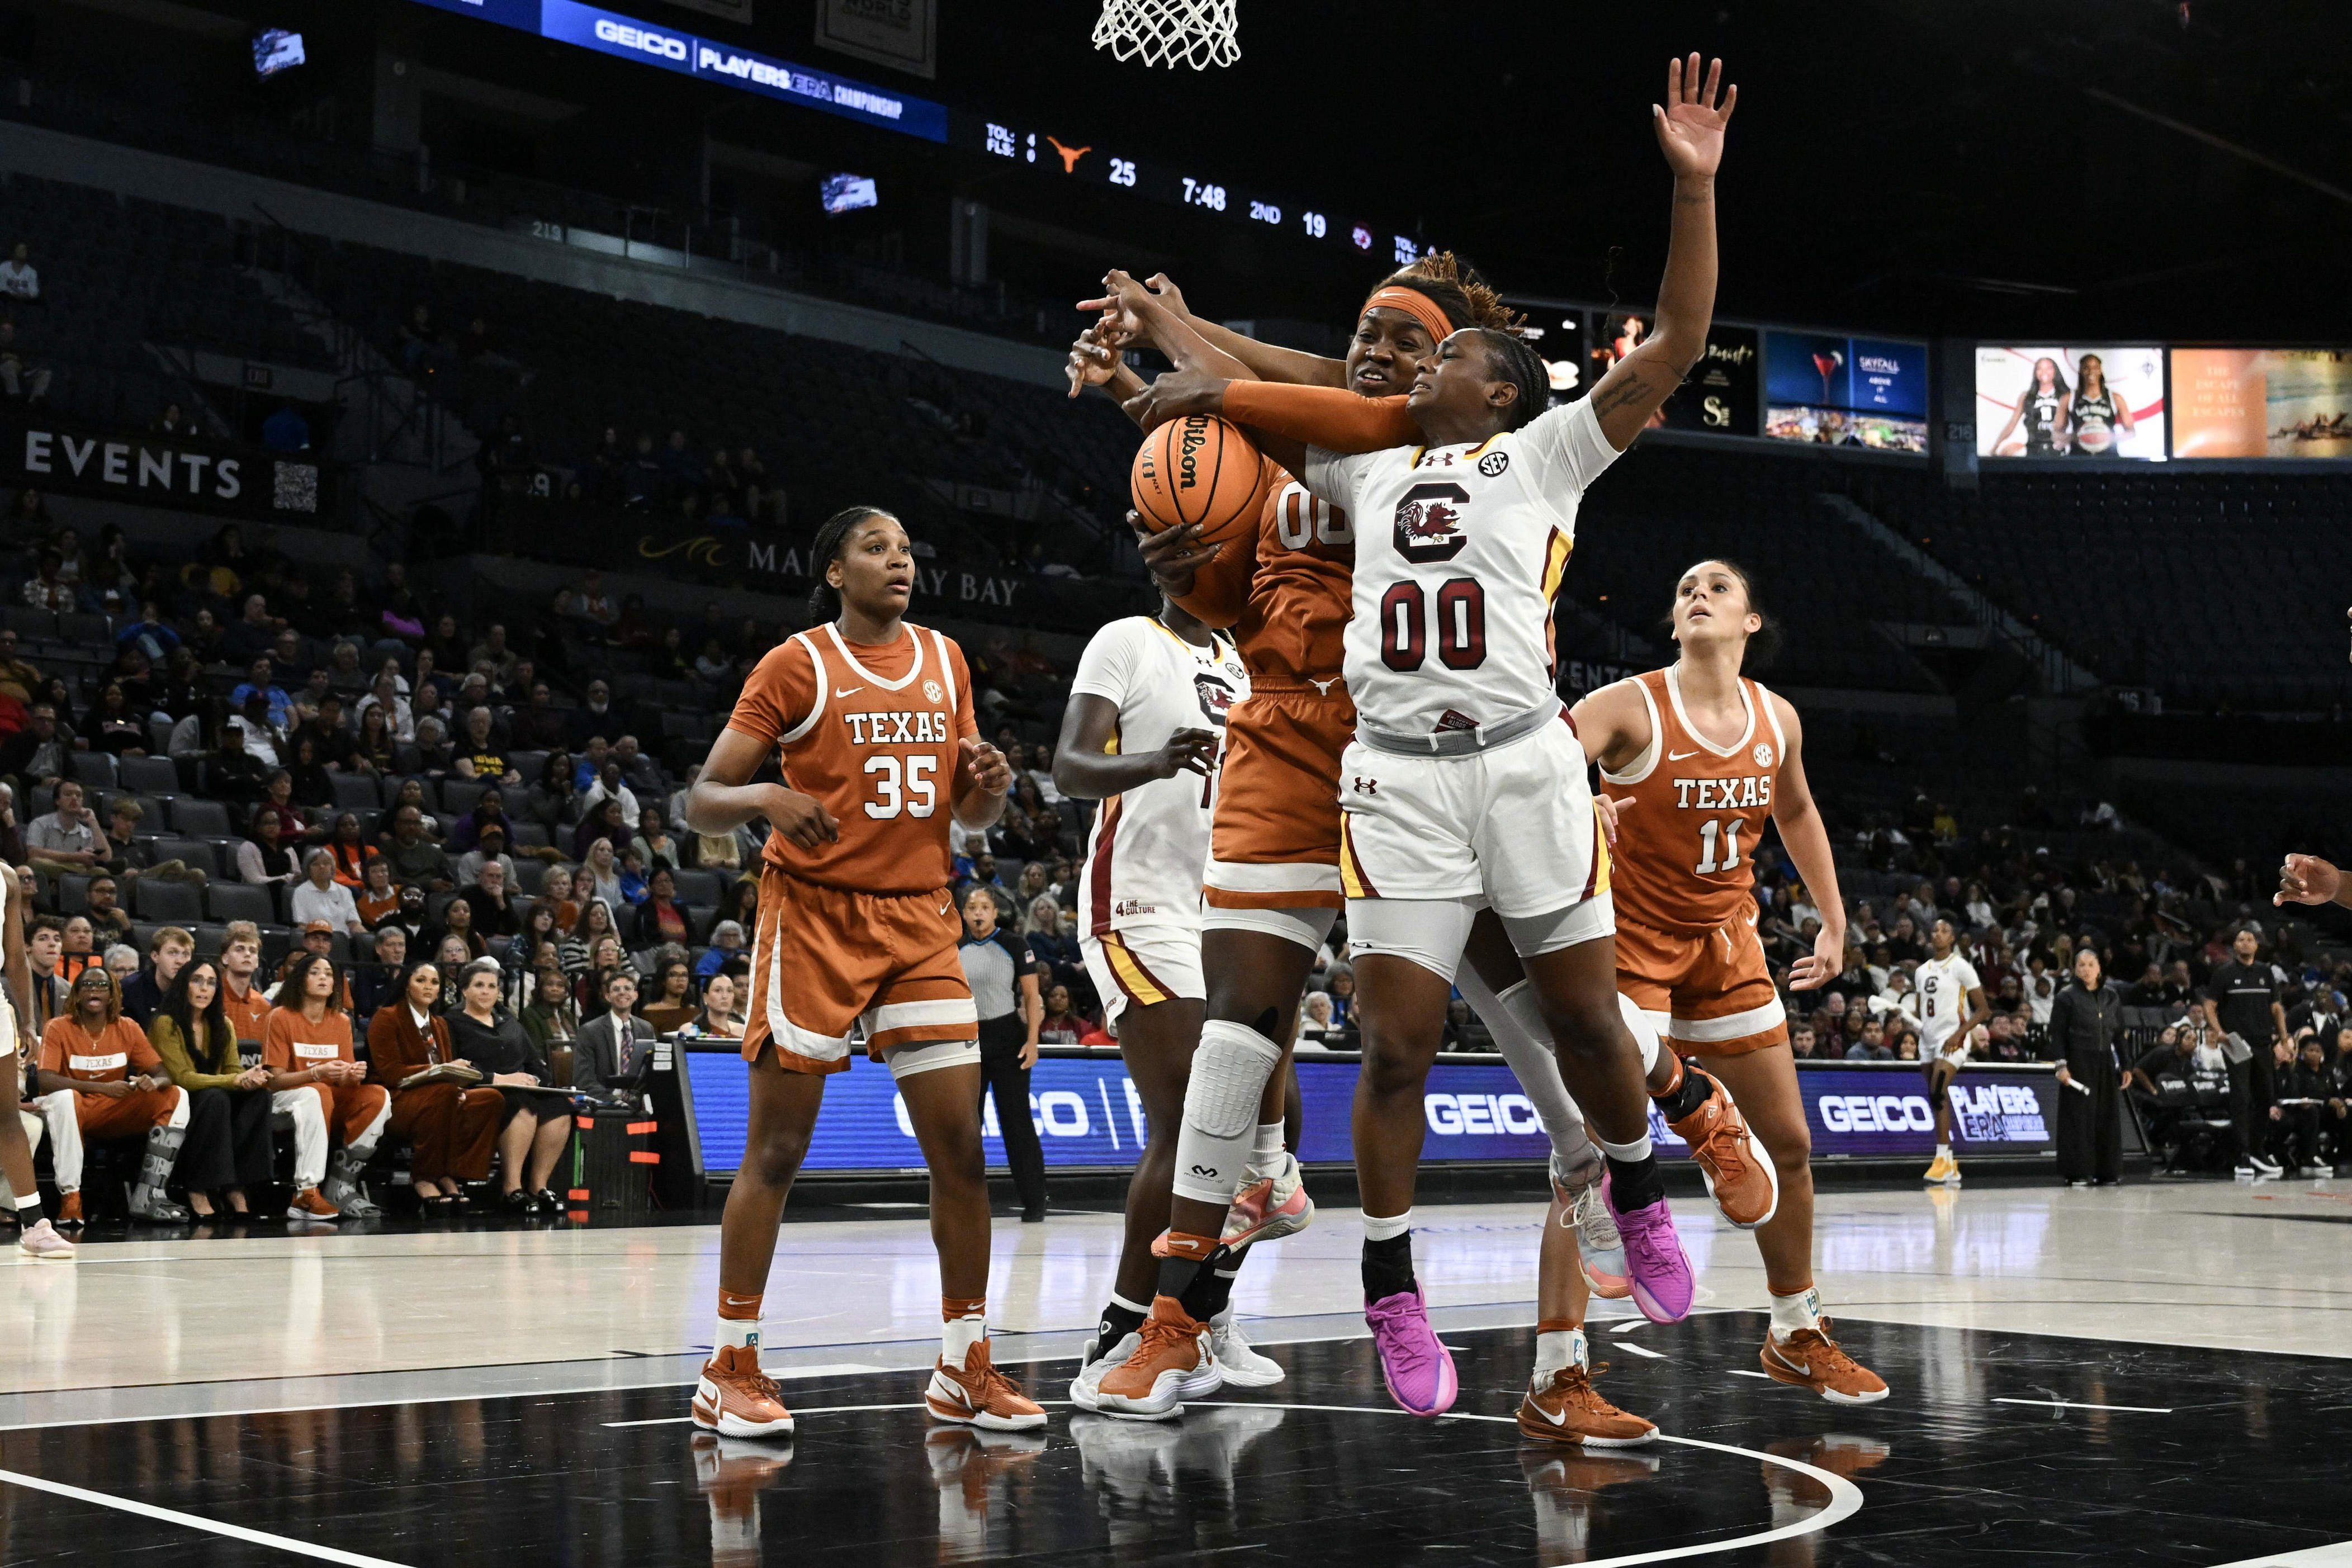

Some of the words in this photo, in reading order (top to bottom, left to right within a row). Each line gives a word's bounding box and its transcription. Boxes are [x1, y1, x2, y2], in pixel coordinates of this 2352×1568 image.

[595, 20, 687, 60] GEICO
[700, 48, 790, 89] PLAYERS
[835, 85, 902, 119] CHAMPIONSHIP
[986, 122, 1015, 144] TOL:
[1026, 133, 1036, 147] 4
[987, 138, 1015, 158] FLS:
[1109, 158, 1136, 187] 25
[1182, 177, 1226, 212] 7:48
[1250, 201, 1281, 225] 2ND
[1303, 211, 1326, 238] 19
[1394, 235, 1418, 254] TOL:
[1395, 249, 1416, 264] FLS
[25, 430, 242, 499] EVENTS
[1180, 416, 1210, 490] Wilson
[1481, 452, 1508, 475] SEC
[1152, 478, 1163, 496] NXT
[959, 572, 1019, 607] BAY
[1380, 577, 1487, 672] 00
[924, 683, 943, 703] SEC
[844, 711, 947, 745] TEXAS
[864, 755, 938, 819] 35
[1673, 775, 1771, 809] TEXAS
[1695, 818, 1744, 875] 11
[1116, 901, 1124, 917] 4
[1126, 906, 1156, 915] CULTURE
[86, 1058, 113, 1068] TEXAS
[304, 1046, 328, 1055] TEXAS
[1947, 1084, 2039, 1115] PLAYERS
[1425, 1093, 1549, 1135] GEIC
[1819, 1096, 1935, 1132] GEICO
[1963, 1114, 2010, 1140] ERA
